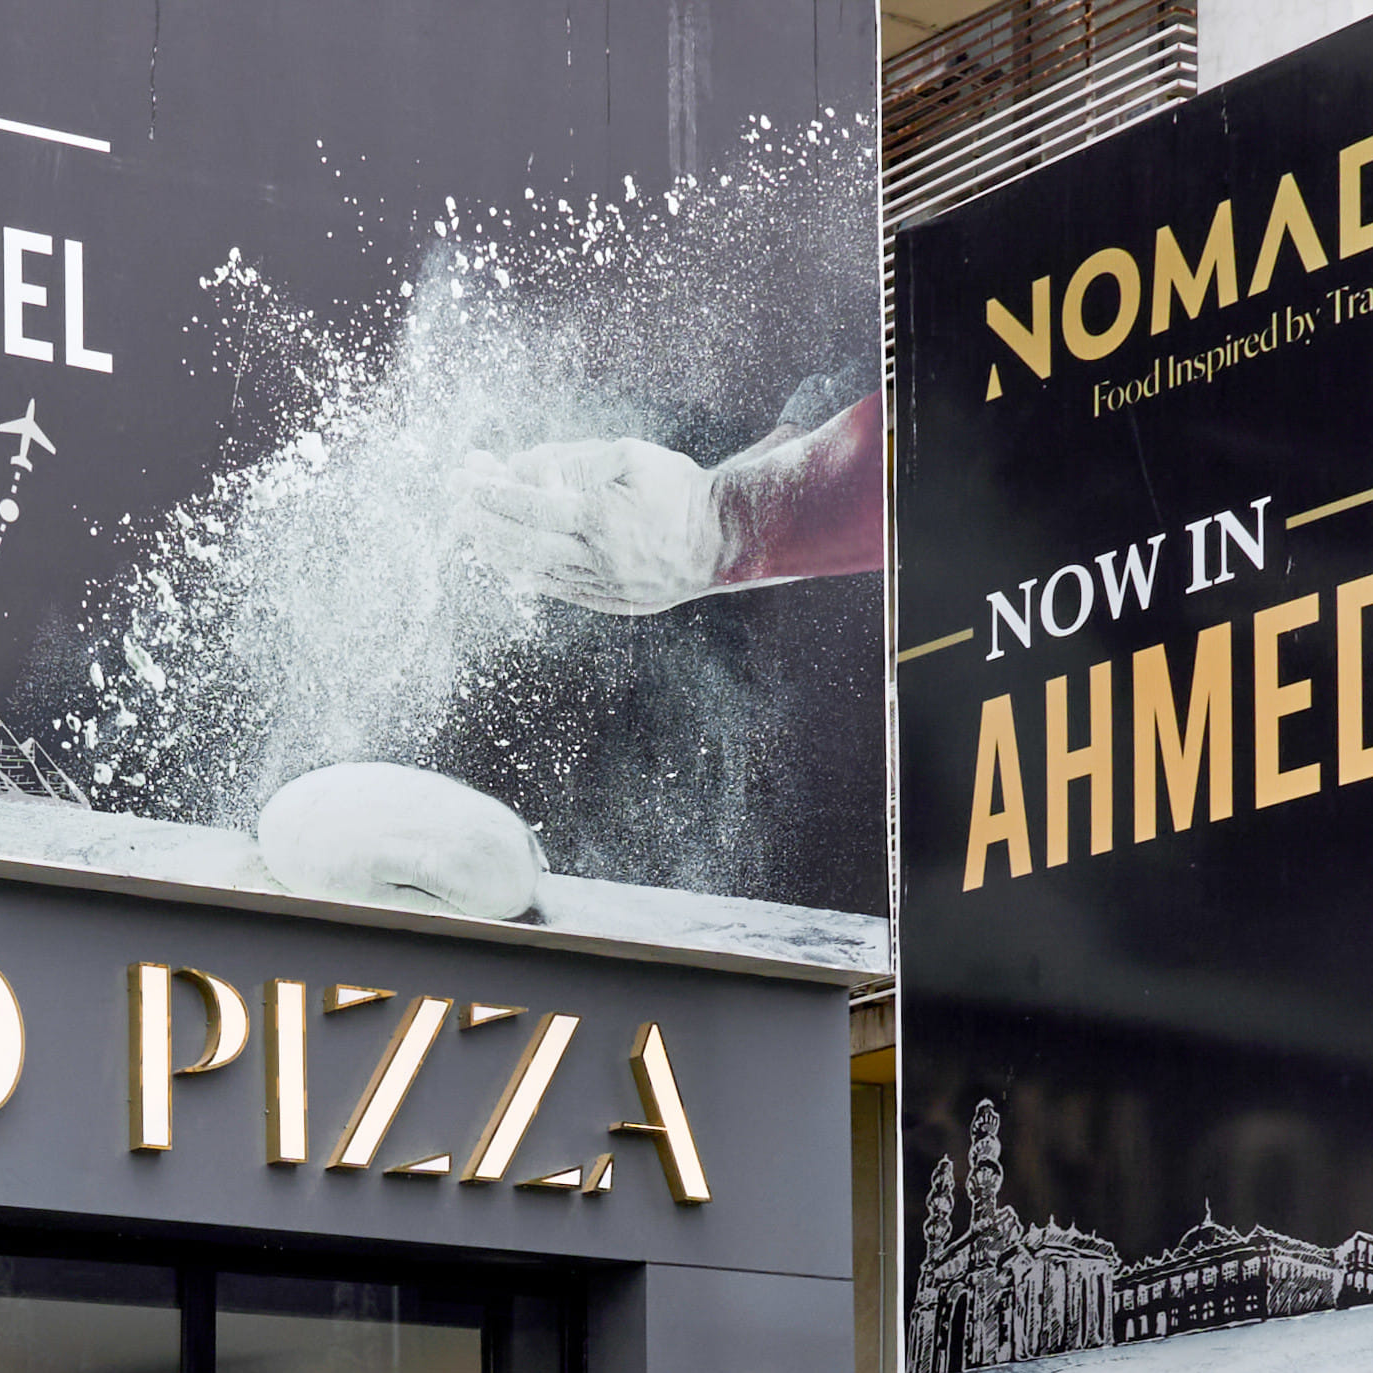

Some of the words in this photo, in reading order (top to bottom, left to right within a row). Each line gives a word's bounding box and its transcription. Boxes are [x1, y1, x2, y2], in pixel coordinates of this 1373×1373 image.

[1093, 357, 1160, 418] Food
[1167, 311, 1278, 389] Inspired
[1285, 305, 1321, 346] by
[985, 532, 1167, 662] NOW
[1184, 495, 1272, 595] IN
[127, 961, 713, 1205] PIZZA
